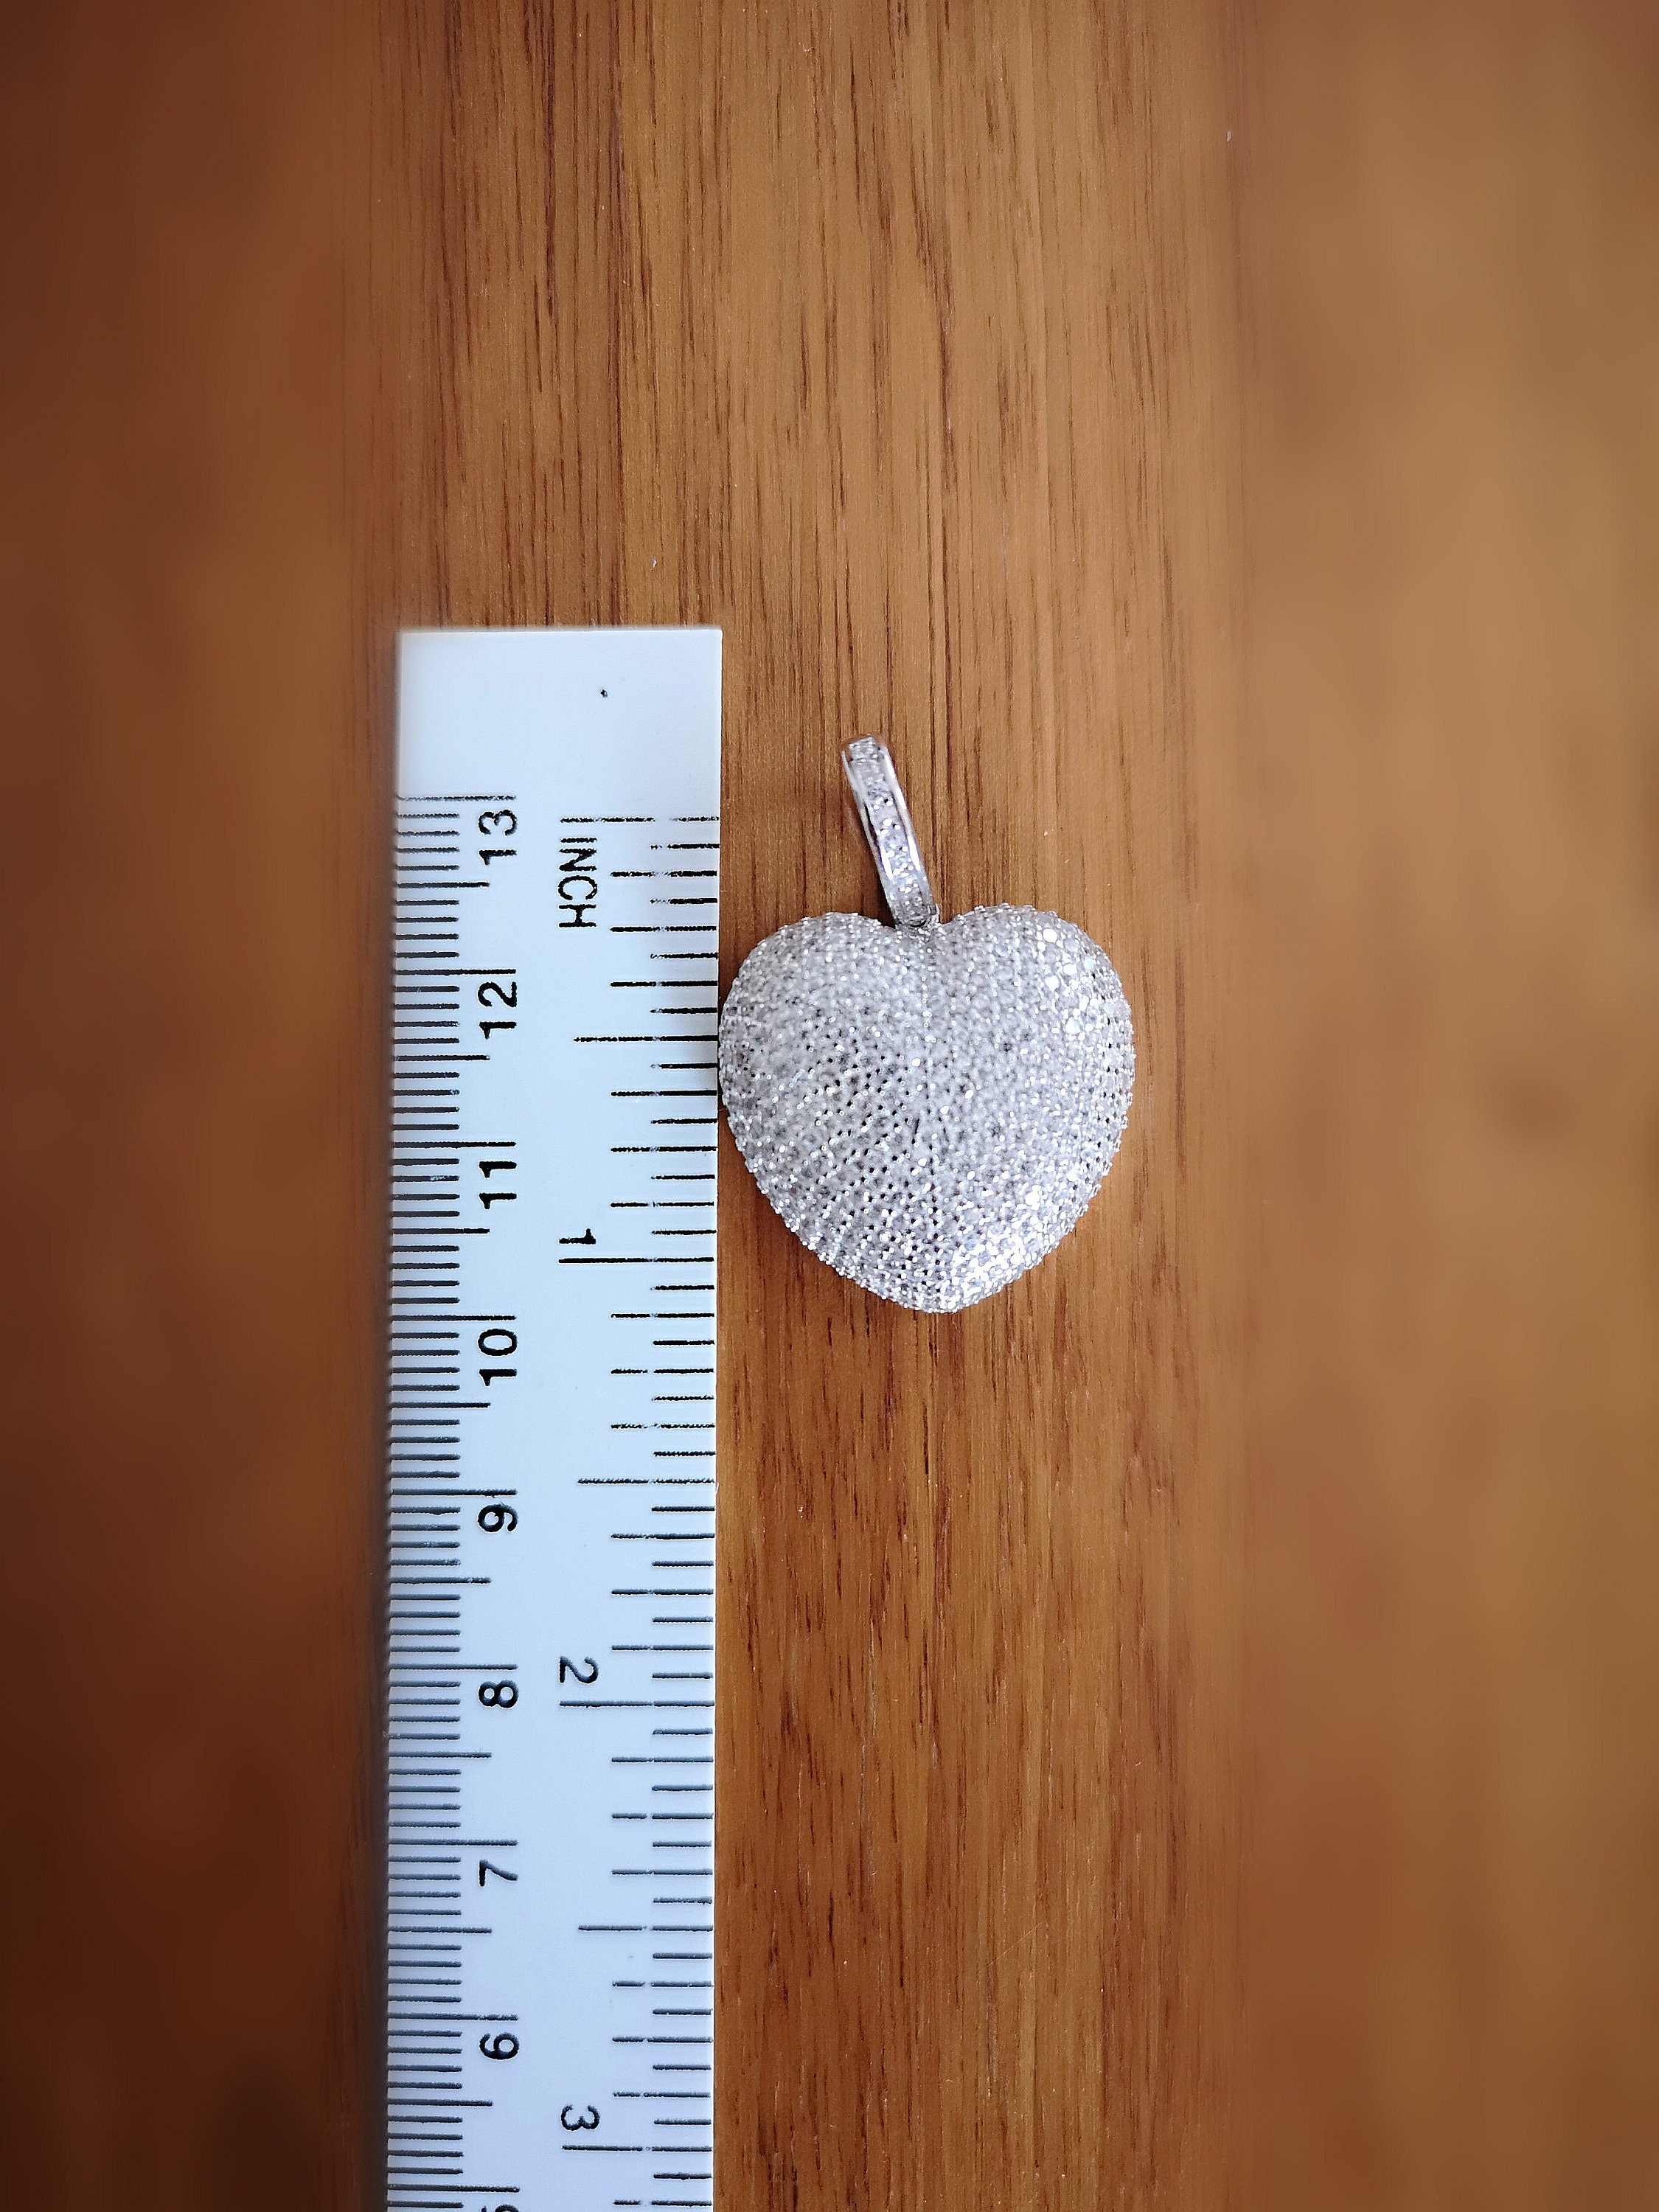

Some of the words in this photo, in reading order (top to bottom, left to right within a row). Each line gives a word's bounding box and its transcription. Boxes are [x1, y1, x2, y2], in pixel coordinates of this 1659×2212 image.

[477, 808, 518, 866] 13
[557, 836, 599, 929] INCH
[476, 981, 518, 1040] 12
[478, 1160, 518, 1211] 11
[558, 1227, 597, 1246] 1
[476, 1327, 518, 1388] 10
[476, 1502, 518, 1534] 9
[558, 1656, 599, 1685] 2
[477, 1680, 519, 1710] 8
[478, 1859, 518, 1888] 7
[478, 2032, 521, 2062] 6
[560, 2104, 602, 2132] 3
